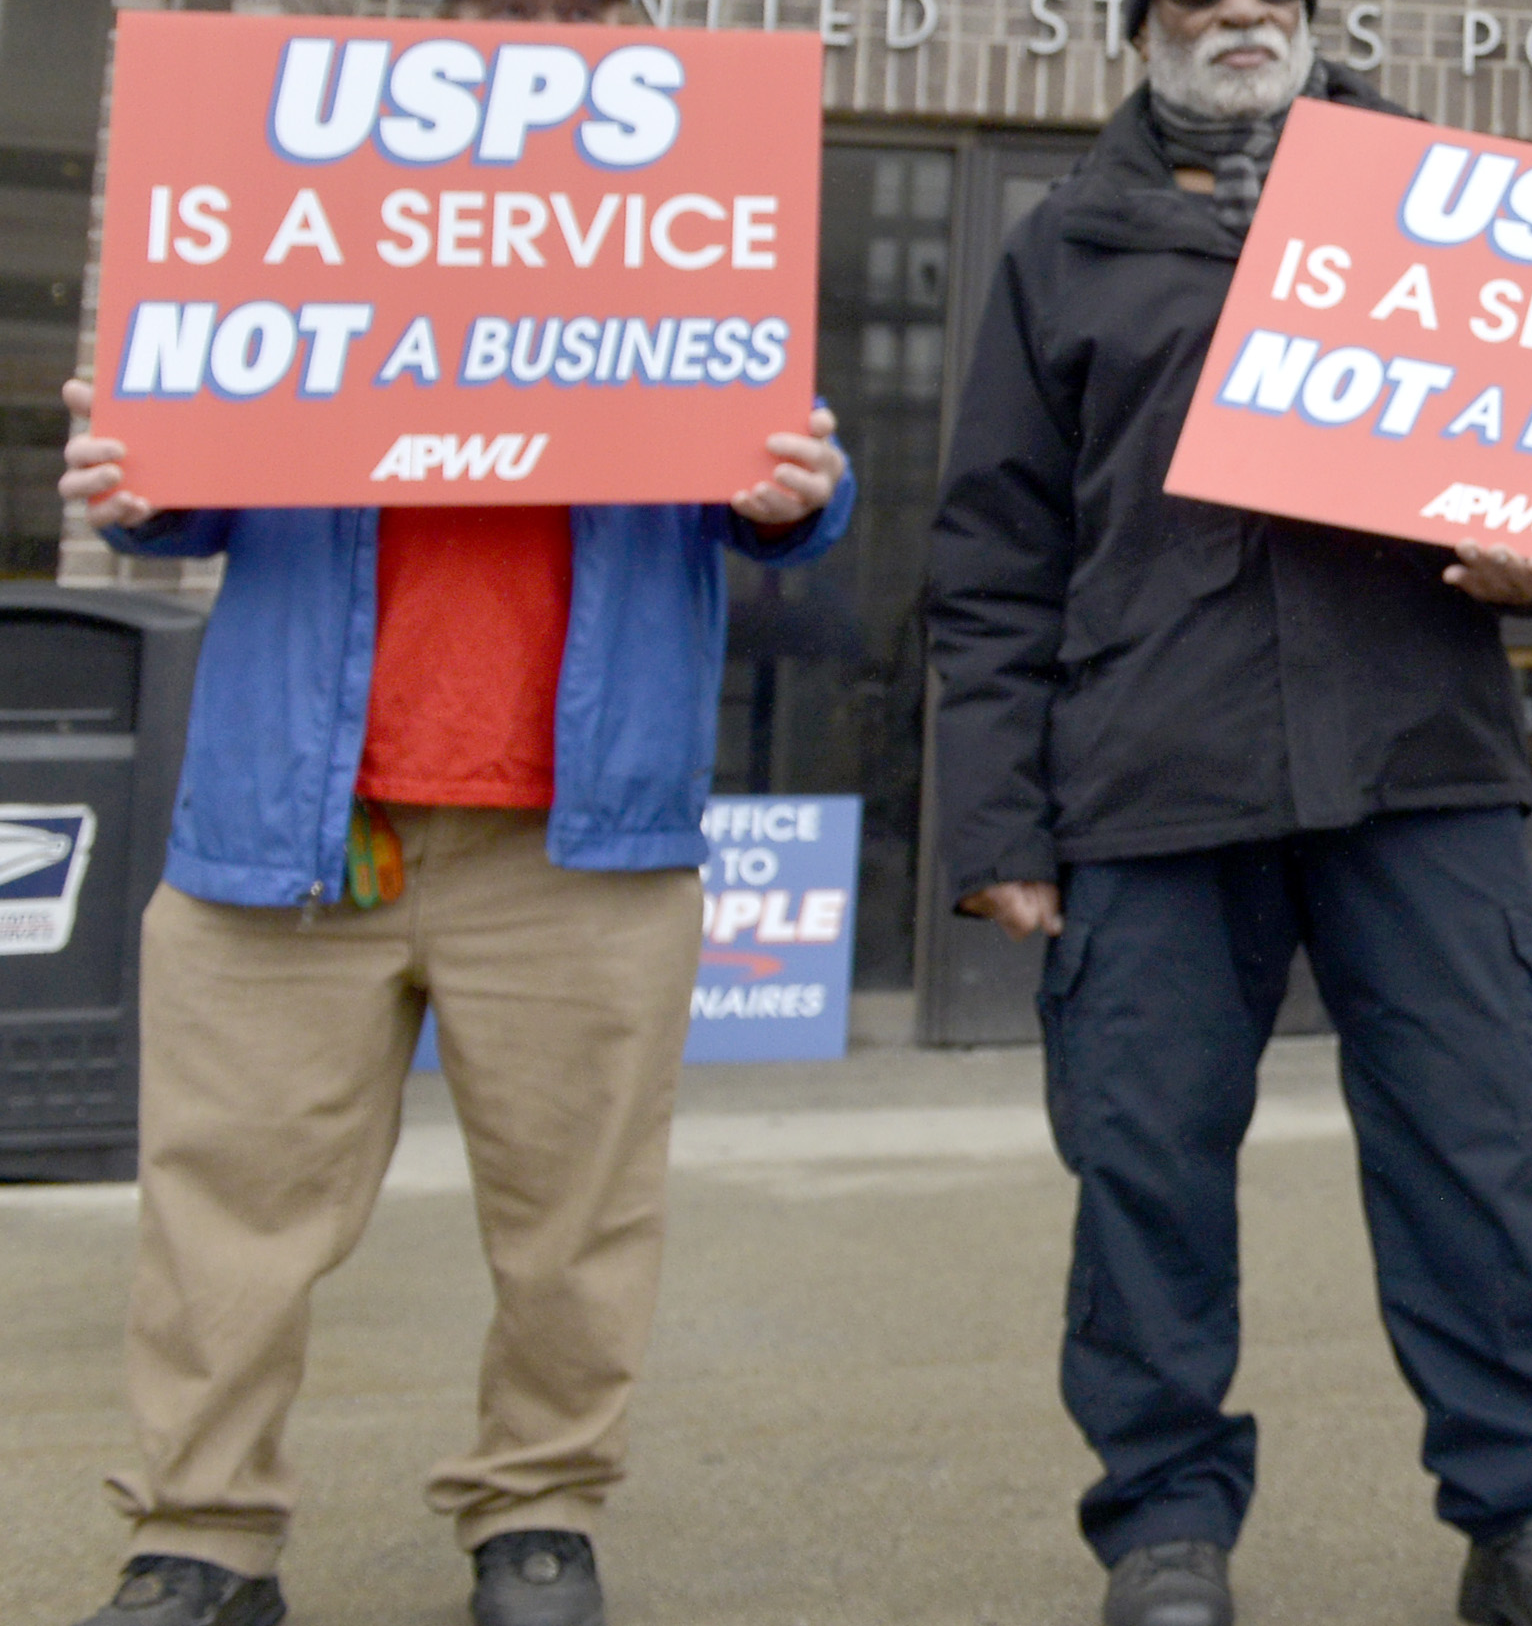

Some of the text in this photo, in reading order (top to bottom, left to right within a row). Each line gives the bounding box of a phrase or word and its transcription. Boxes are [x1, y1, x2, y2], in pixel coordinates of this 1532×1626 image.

[268, 36, 685, 169] USPS
[146, 185, 778, 269] IS A SERVICE
[1270, 237, 1353, 312] IS
[1370, 263, 1439, 331] A
[115, 300, 790, 401] NOT A BUSINESS
[1215, 329, 1454, 439] NOT
[1442, 384, 1503, 444] A
[369, 432, 549, 481] APWU
[720, 846, 780, 886] TO
[702, 888, 848, 946] PLE
[690, 982, 826, 1020] NAIRES
